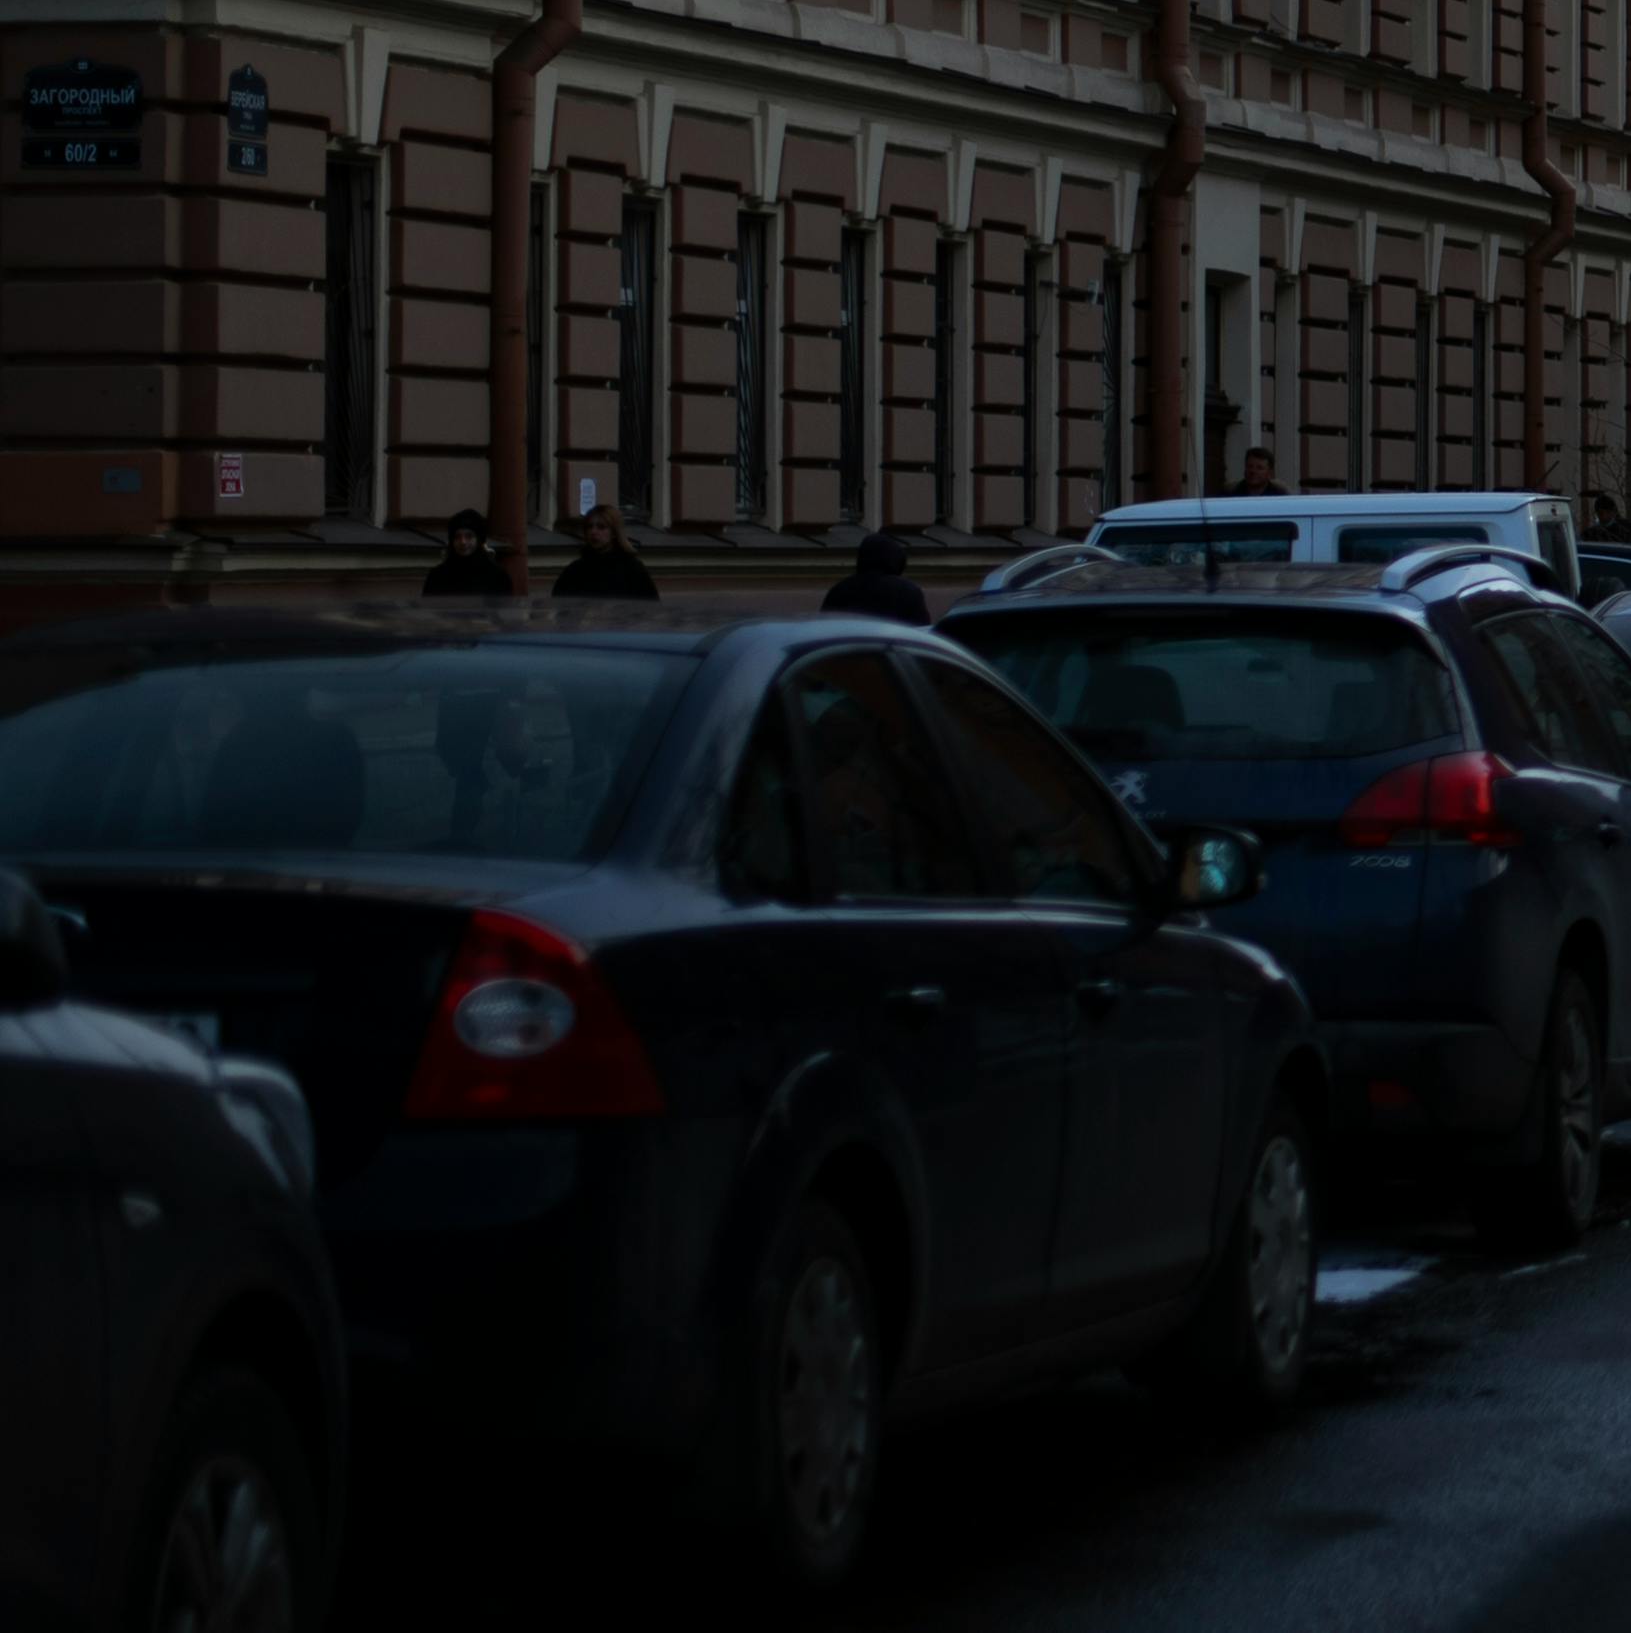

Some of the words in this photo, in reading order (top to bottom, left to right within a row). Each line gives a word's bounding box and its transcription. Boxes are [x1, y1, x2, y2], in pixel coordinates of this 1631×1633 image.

[29, 85, 136, 107] ЗАГОРОДНЫЙ
[65, 144, 97, 163] 60/2
[1349, 854, 1412, 868] 2008
